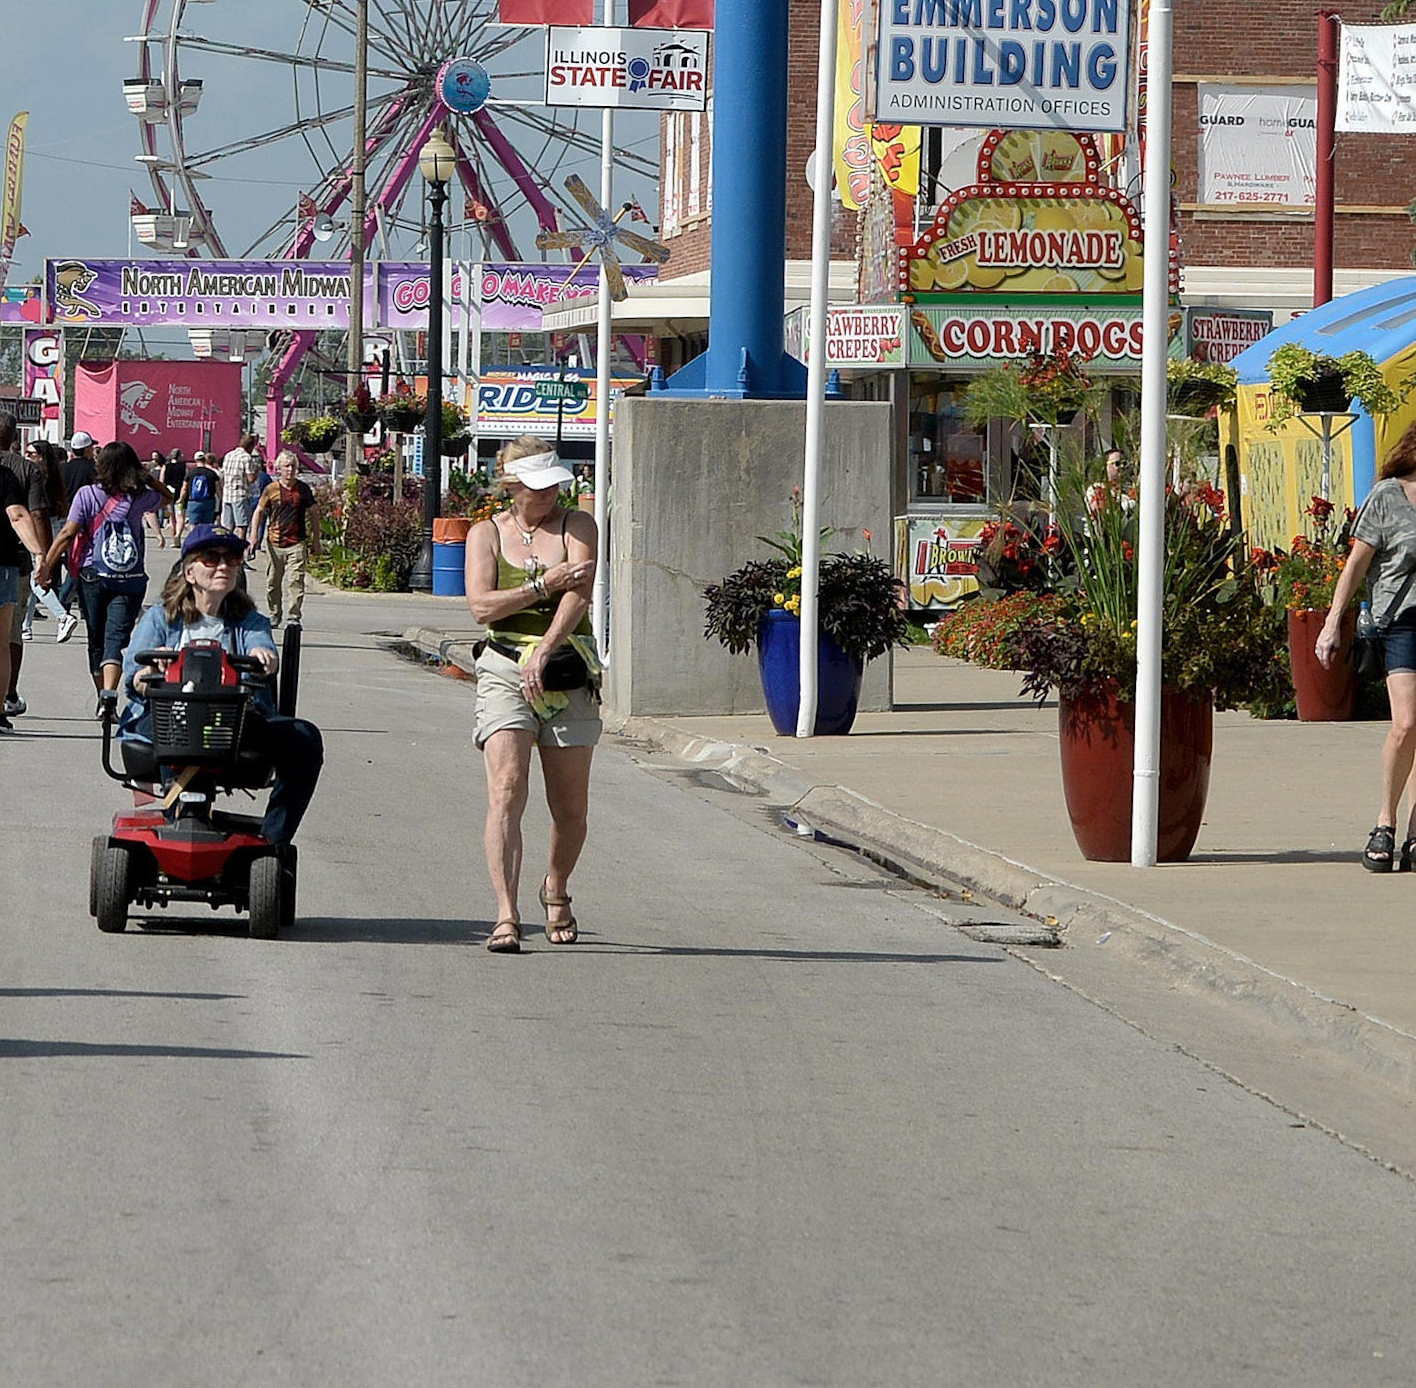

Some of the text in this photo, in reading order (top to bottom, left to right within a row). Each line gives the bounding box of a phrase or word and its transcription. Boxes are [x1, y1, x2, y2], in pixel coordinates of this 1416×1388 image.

[554, 50, 627, 65] ILLINOIS
[890, 35, 1118, 91] BUILDING
[550, 66, 703, 91] STATE FAIR
[889, 93, 1112, 116] ADMINISTRATION OFFICES
[1200, 115, 1245, 126] GUARD
[1213, 172, 1290, 182] PAWNEE LUMBER
[1215, 191, 1290, 202] 217-625-2771
[937, 234, 978, 261] FRESH
[978, 231, 1122, 265] LEMONADE
[122, 267, 353, 300] NORTH AMERICAN MIDWAY
[503, 273, 557, 304] MAKE
[123, 302, 352, 316] ENTERTAINMENT
[825, 315, 900, 337] RAWBERRY
[1192, 318, 1268, 340] STRAWBERRY
[827, 338, 879, 359] CREPES
[943, 320, 1144, 355] CORN DOGS
[169, 383, 191, 395] NORTH
[535, 381, 576, 397] CENTRAL
[168, 395, 201, 407] AMERICAN
